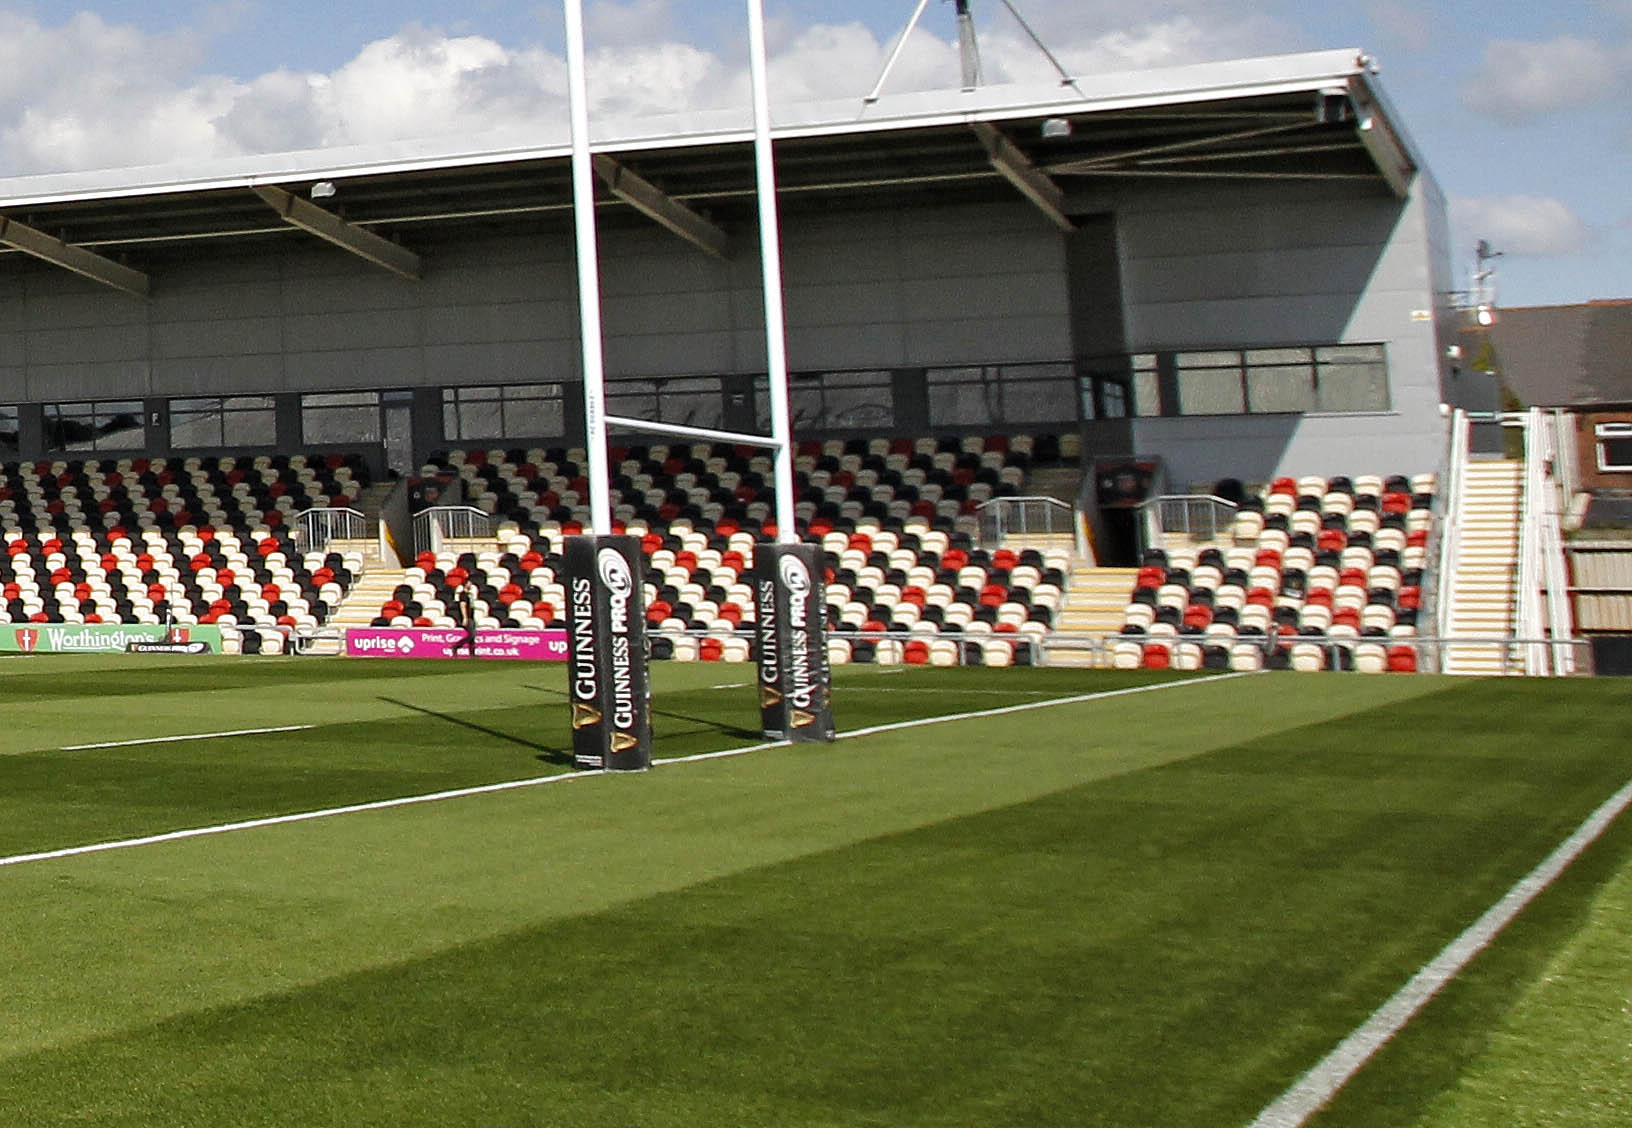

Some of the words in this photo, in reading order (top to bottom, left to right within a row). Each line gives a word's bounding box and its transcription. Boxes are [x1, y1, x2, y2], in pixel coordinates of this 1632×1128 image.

[47, 628, 156, 652] Worthington's
[354, 635, 396, 651] uprise
[485, 635, 503, 643] and
[503, 634, 541, 646] Signage
[574, 577, 597, 700] GUINNESS
[760, 579, 779, 683] GUINNESS
[791, 630, 814, 708] GUINNESS
[609, 635, 633, 729] GUINNESS
